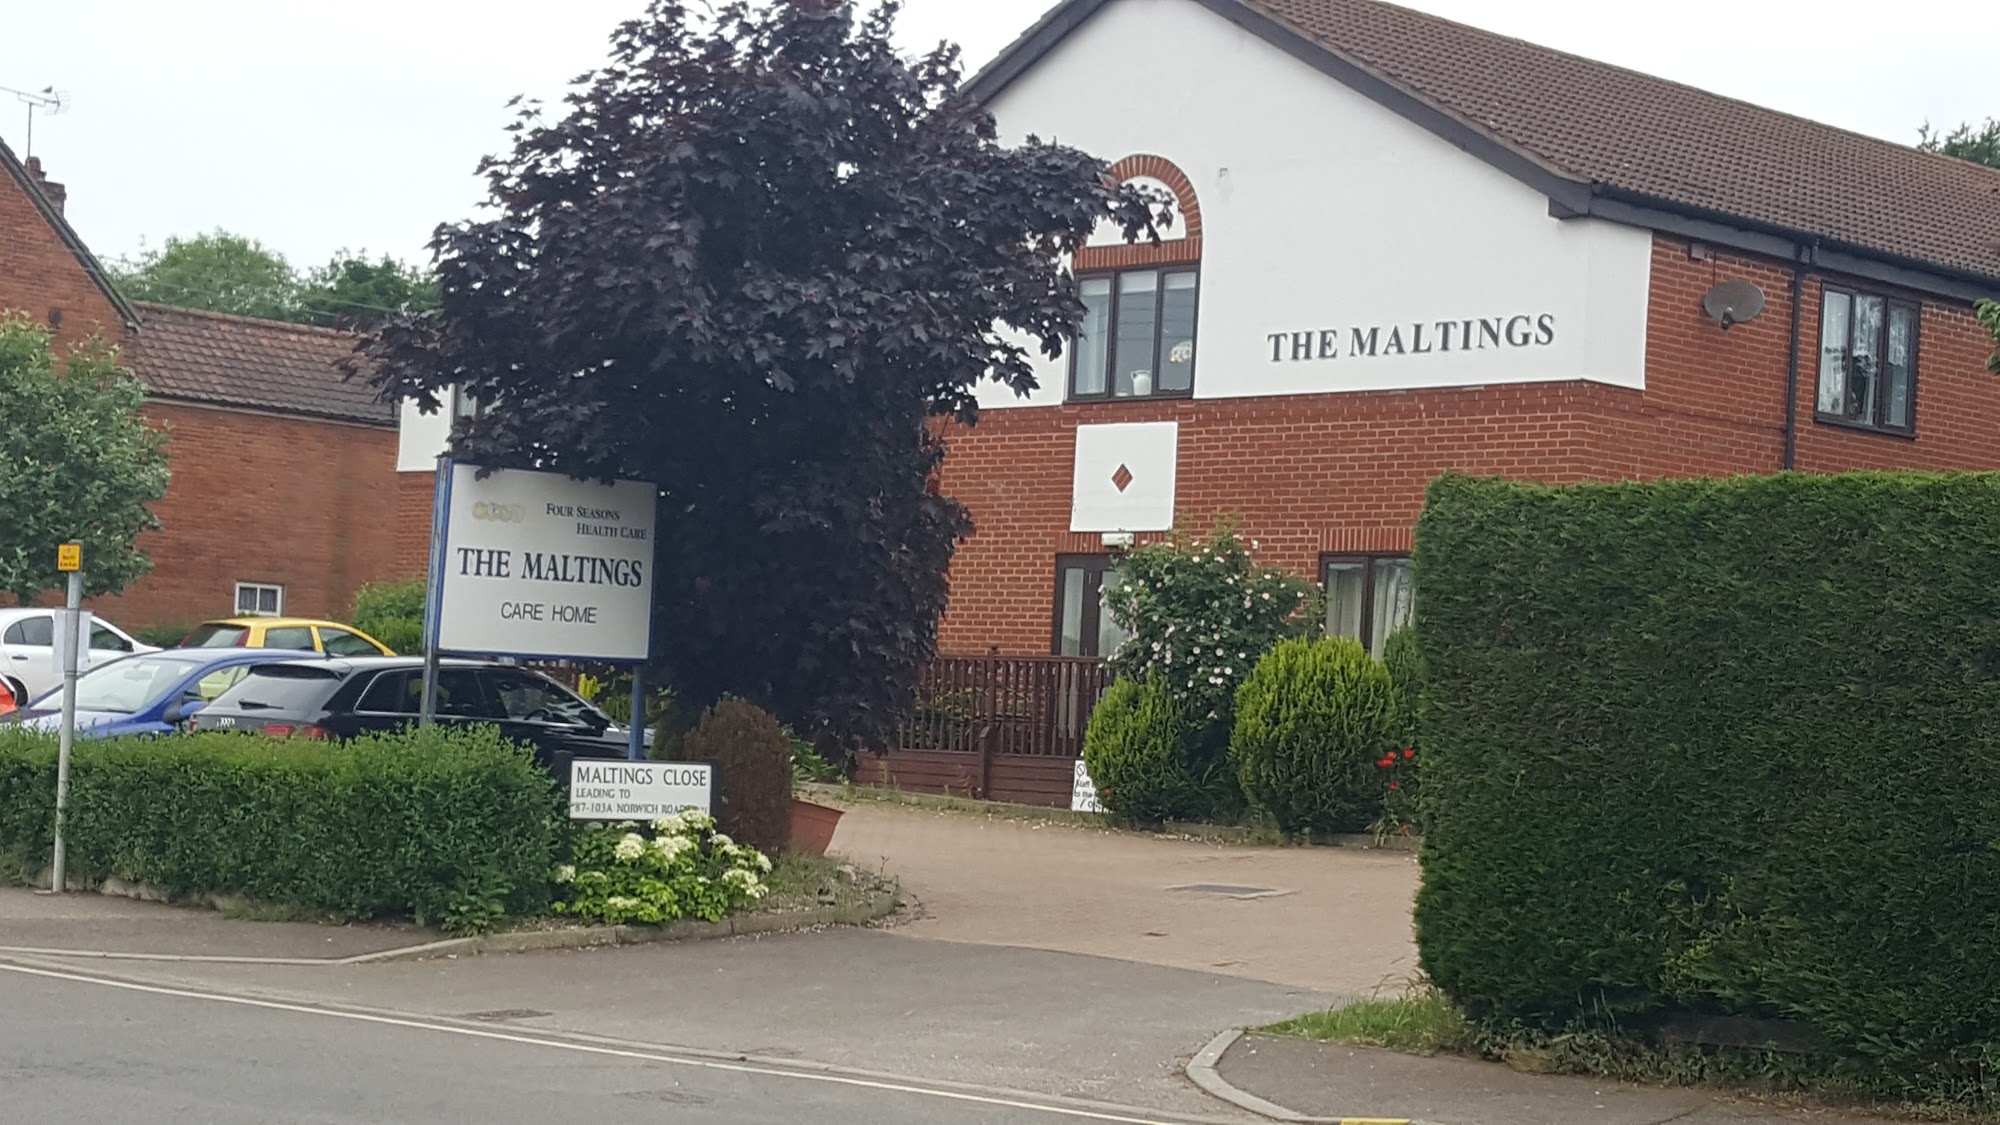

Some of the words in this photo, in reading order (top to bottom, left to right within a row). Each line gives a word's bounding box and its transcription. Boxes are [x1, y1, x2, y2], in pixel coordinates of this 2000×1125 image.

[1267, 329, 1338, 362] THE
[1350, 313, 1554, 357] MALTINGS
[546, 503, 574, 518] FOUR
[576, 506, 620, 521] SEASONS
[576, 522, 617, 538] HEALTH
[620, 527, 647, 540] CARE
[457, 547, 511, 578] THE
[521, 552, 642, 587] MALTINGS
[501, 602, 544, 621] CARE
[552, 605, 597, 624] HOME
[577, 766, 653, 785] MALTINGS
[663, 769, 707, 787] CLOSE
[576, 788, 615, 799] LEADING
[619, 789, 631, 799] TO
[616, 803, 658, 814] NORWICH
